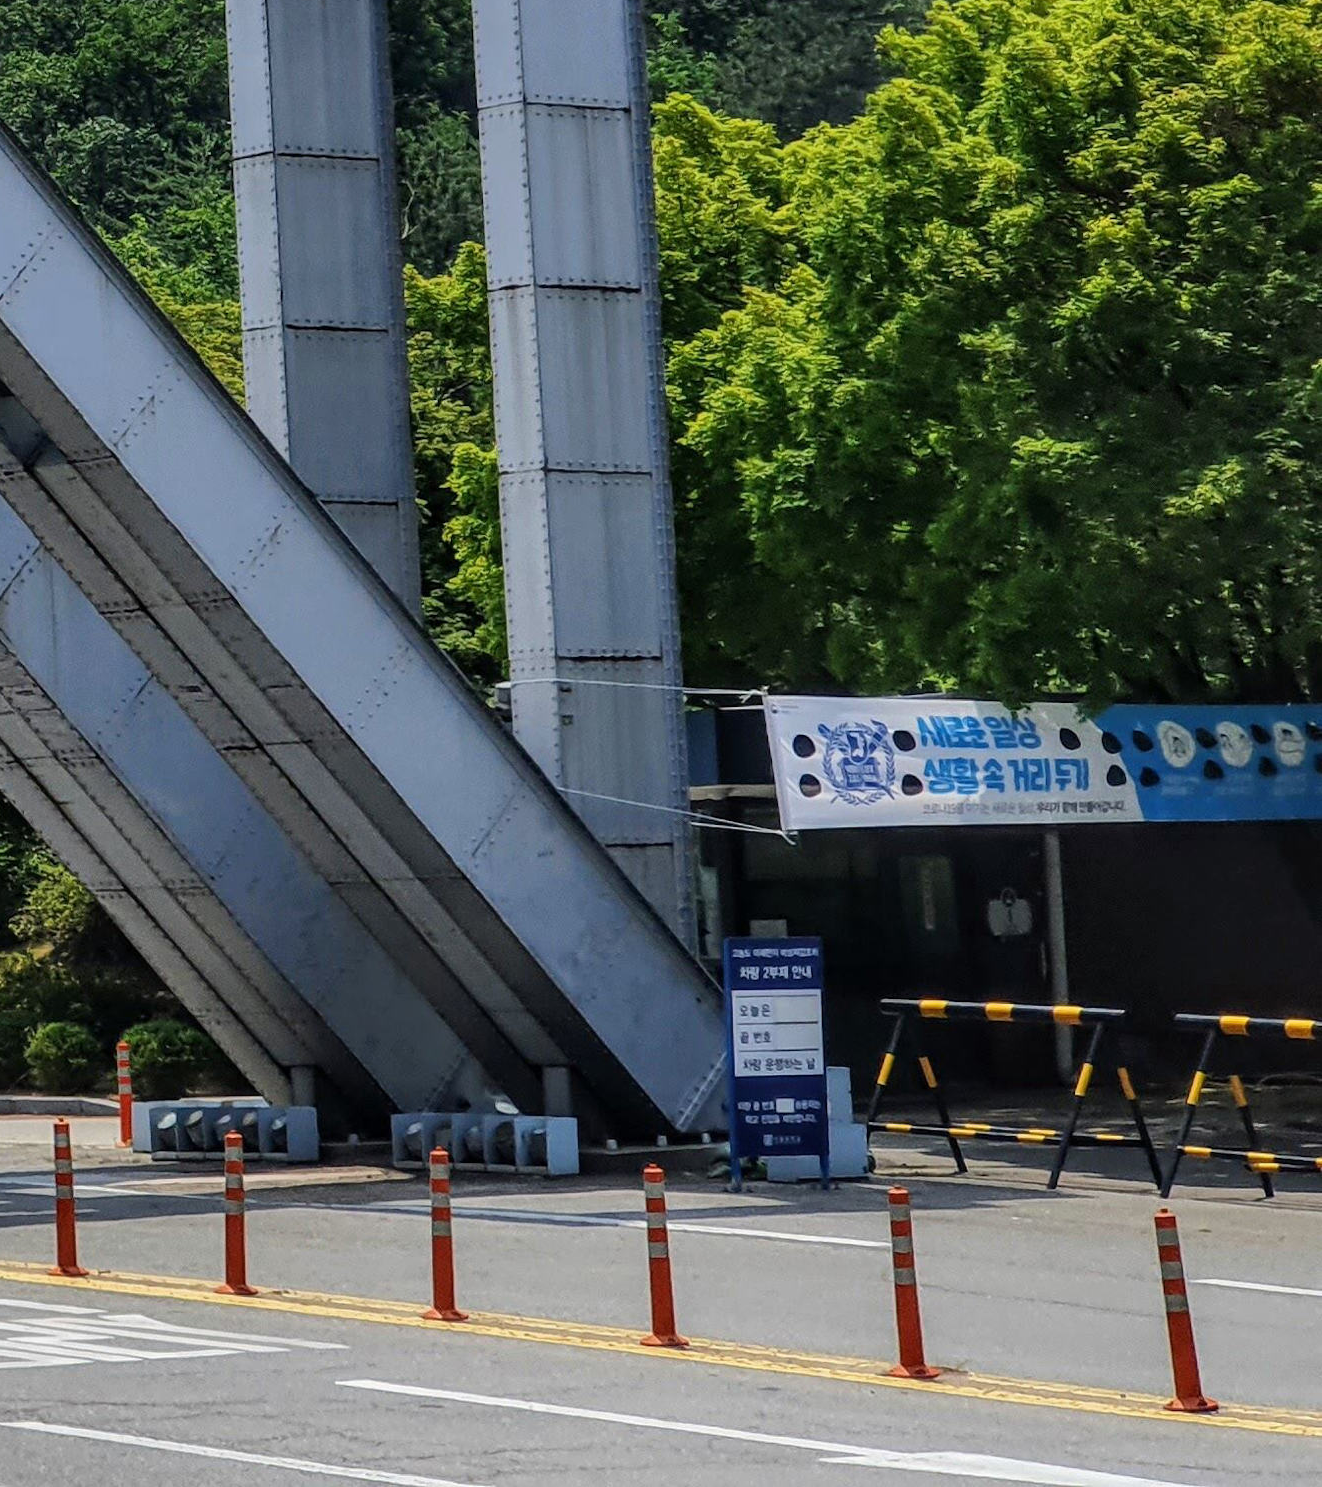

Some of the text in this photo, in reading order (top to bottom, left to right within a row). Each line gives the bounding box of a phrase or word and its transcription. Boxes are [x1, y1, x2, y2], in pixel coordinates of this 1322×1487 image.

[916, 716, 1042, 749] 새로운 일상
[923, 757, 1090, 795] 생활 속 거리 두기
[740, 966, 812, 980] 차량 2부제 안내
[740, 1004, 771, 1017] 오늘은
[753, 1031, 771, 1043] 번호
[743, 1058, 762, 1072] 차량
